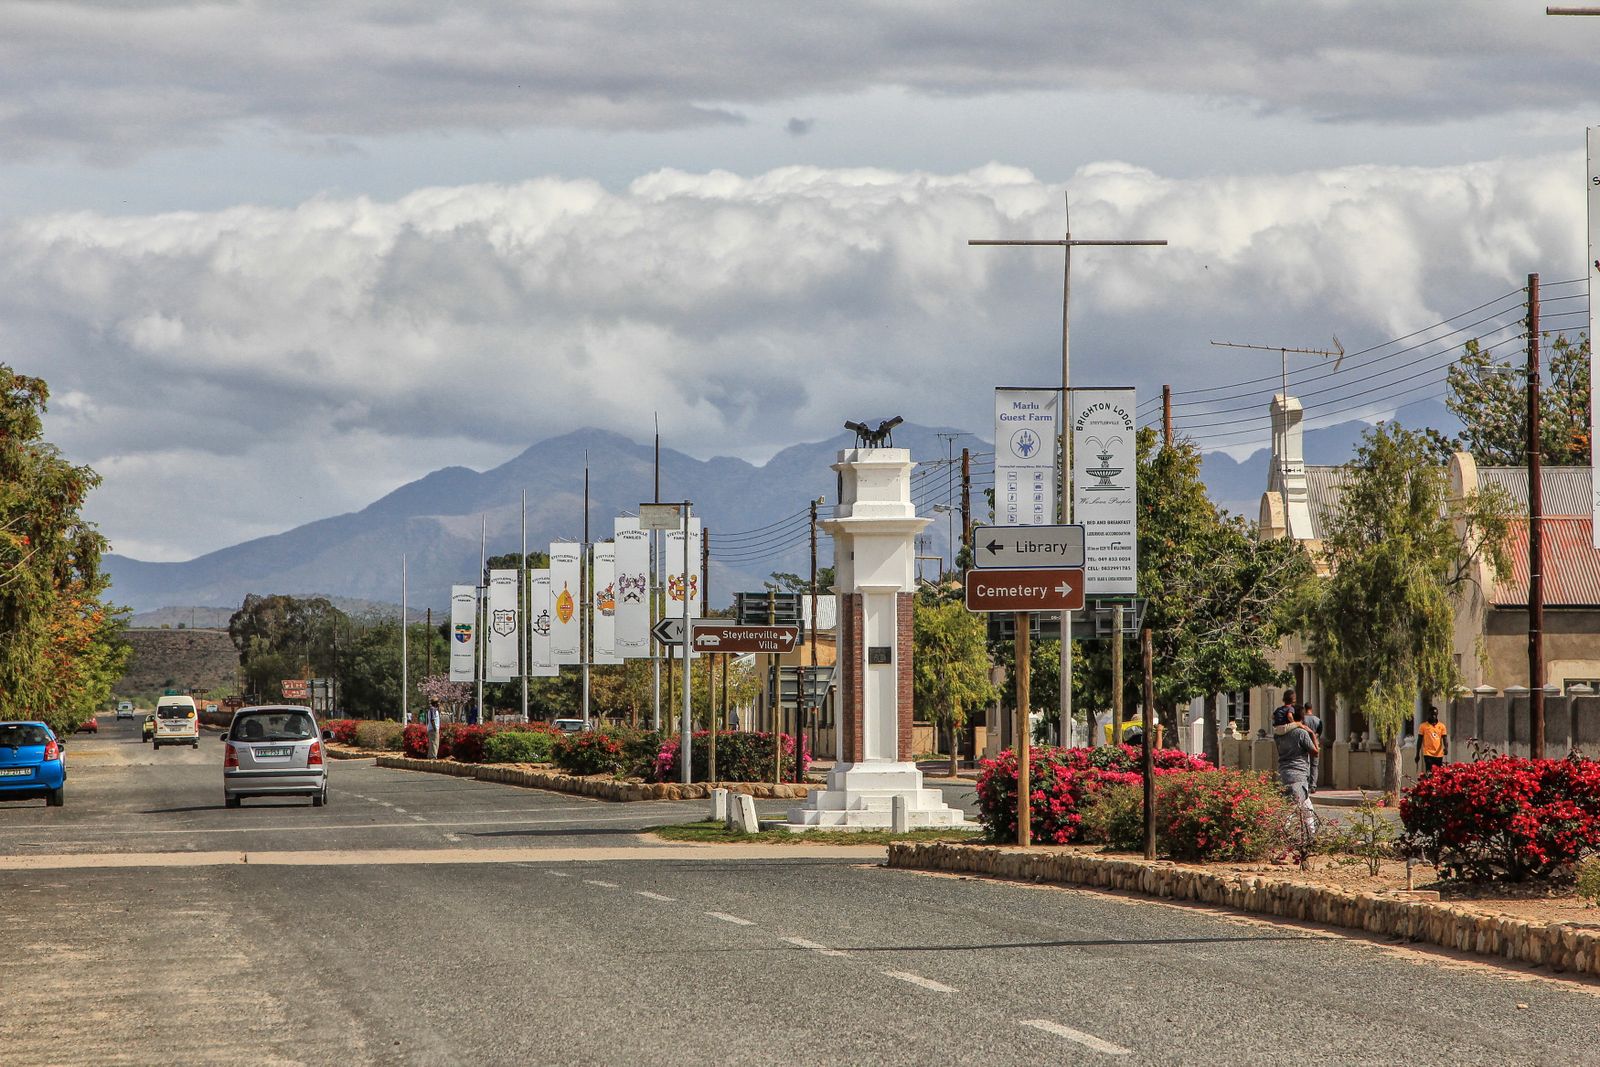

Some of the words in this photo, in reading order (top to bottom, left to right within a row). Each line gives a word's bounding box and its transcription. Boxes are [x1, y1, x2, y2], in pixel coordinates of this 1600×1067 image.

[1013, 402, 1039, 410] Marlu
[1000, 413, 1026, 421] Guest
[1028, 413, 1053, 421] Farm
[1076, 402, 1110, 432] BRIGHTON
[1113, 405, 1134, 431] LODGE
[1108, 497, 1132, 506] People
[1016, 541, 1068, 556] Library
[976, 584, 1048, 600] Cemetery
[722, 630, 778, 640] Steytlerville
[758, 641, 778, 649] Villa
